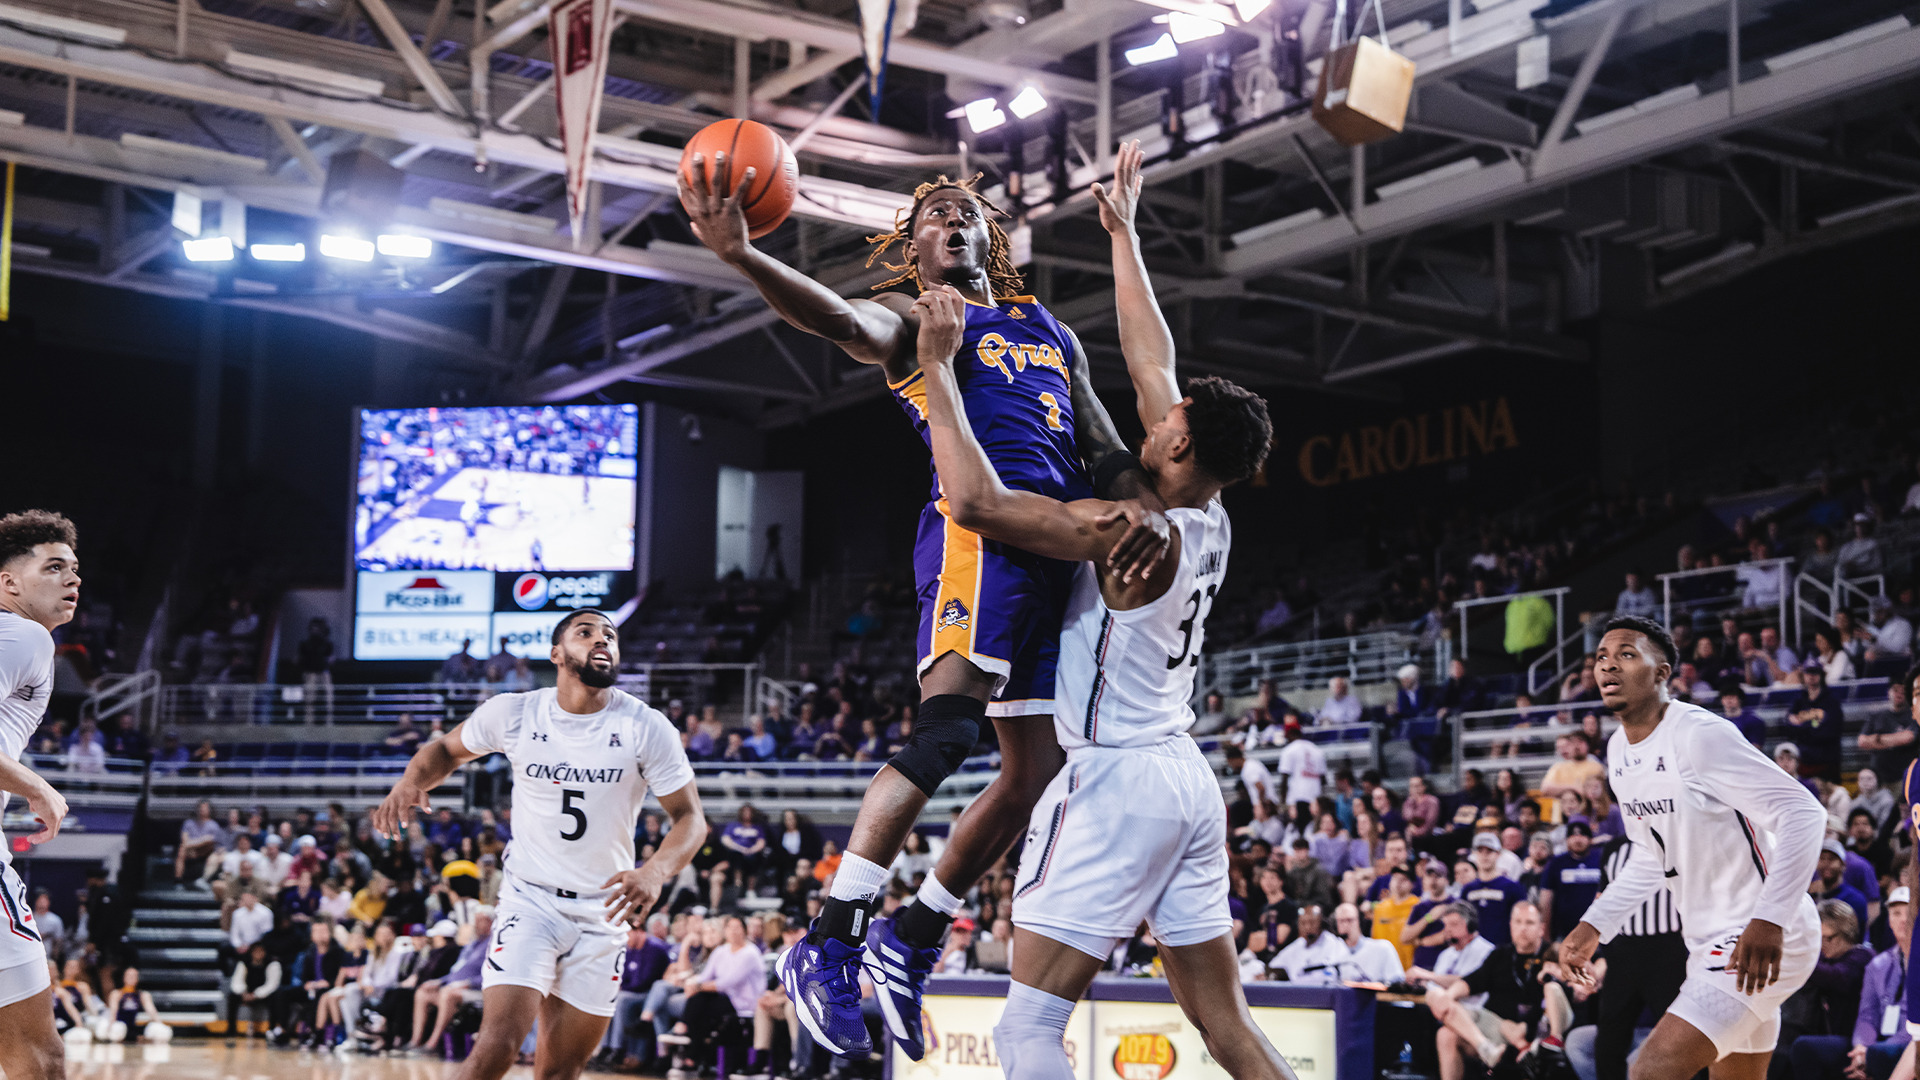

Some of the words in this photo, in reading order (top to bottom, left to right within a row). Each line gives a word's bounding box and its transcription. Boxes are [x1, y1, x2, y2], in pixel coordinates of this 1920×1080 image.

[1298, 396, 1519, 487] CAROLINA
[548, 573, 610, 599] pepsi
[506, 627, 551, 648] opti
[526, 763, 624, 784] CINCINNATI
[560, 789, 587, 841] 5
[945, 1032, 998, 1067] PIRA
